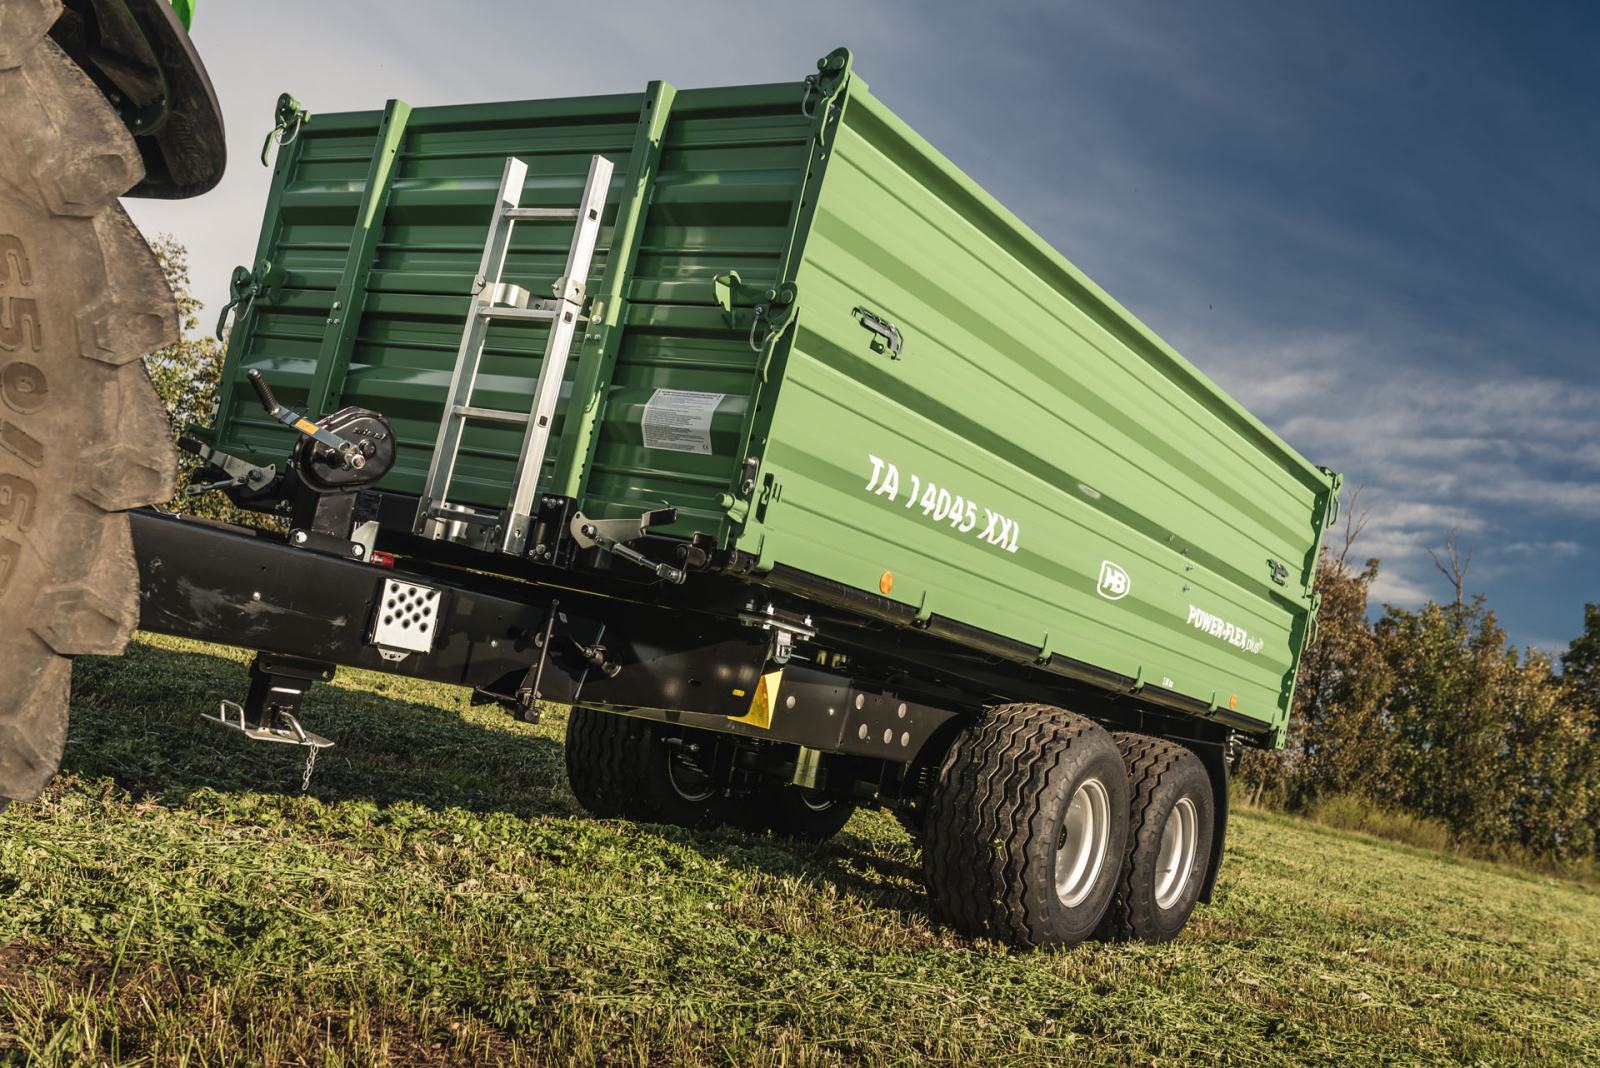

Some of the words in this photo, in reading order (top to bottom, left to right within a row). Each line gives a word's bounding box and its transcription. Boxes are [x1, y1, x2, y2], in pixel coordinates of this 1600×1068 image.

[865, 454, 899, 501] TA
[905, 475, 977, 532] 14045
[976, 508, 1019, 553] XXL
